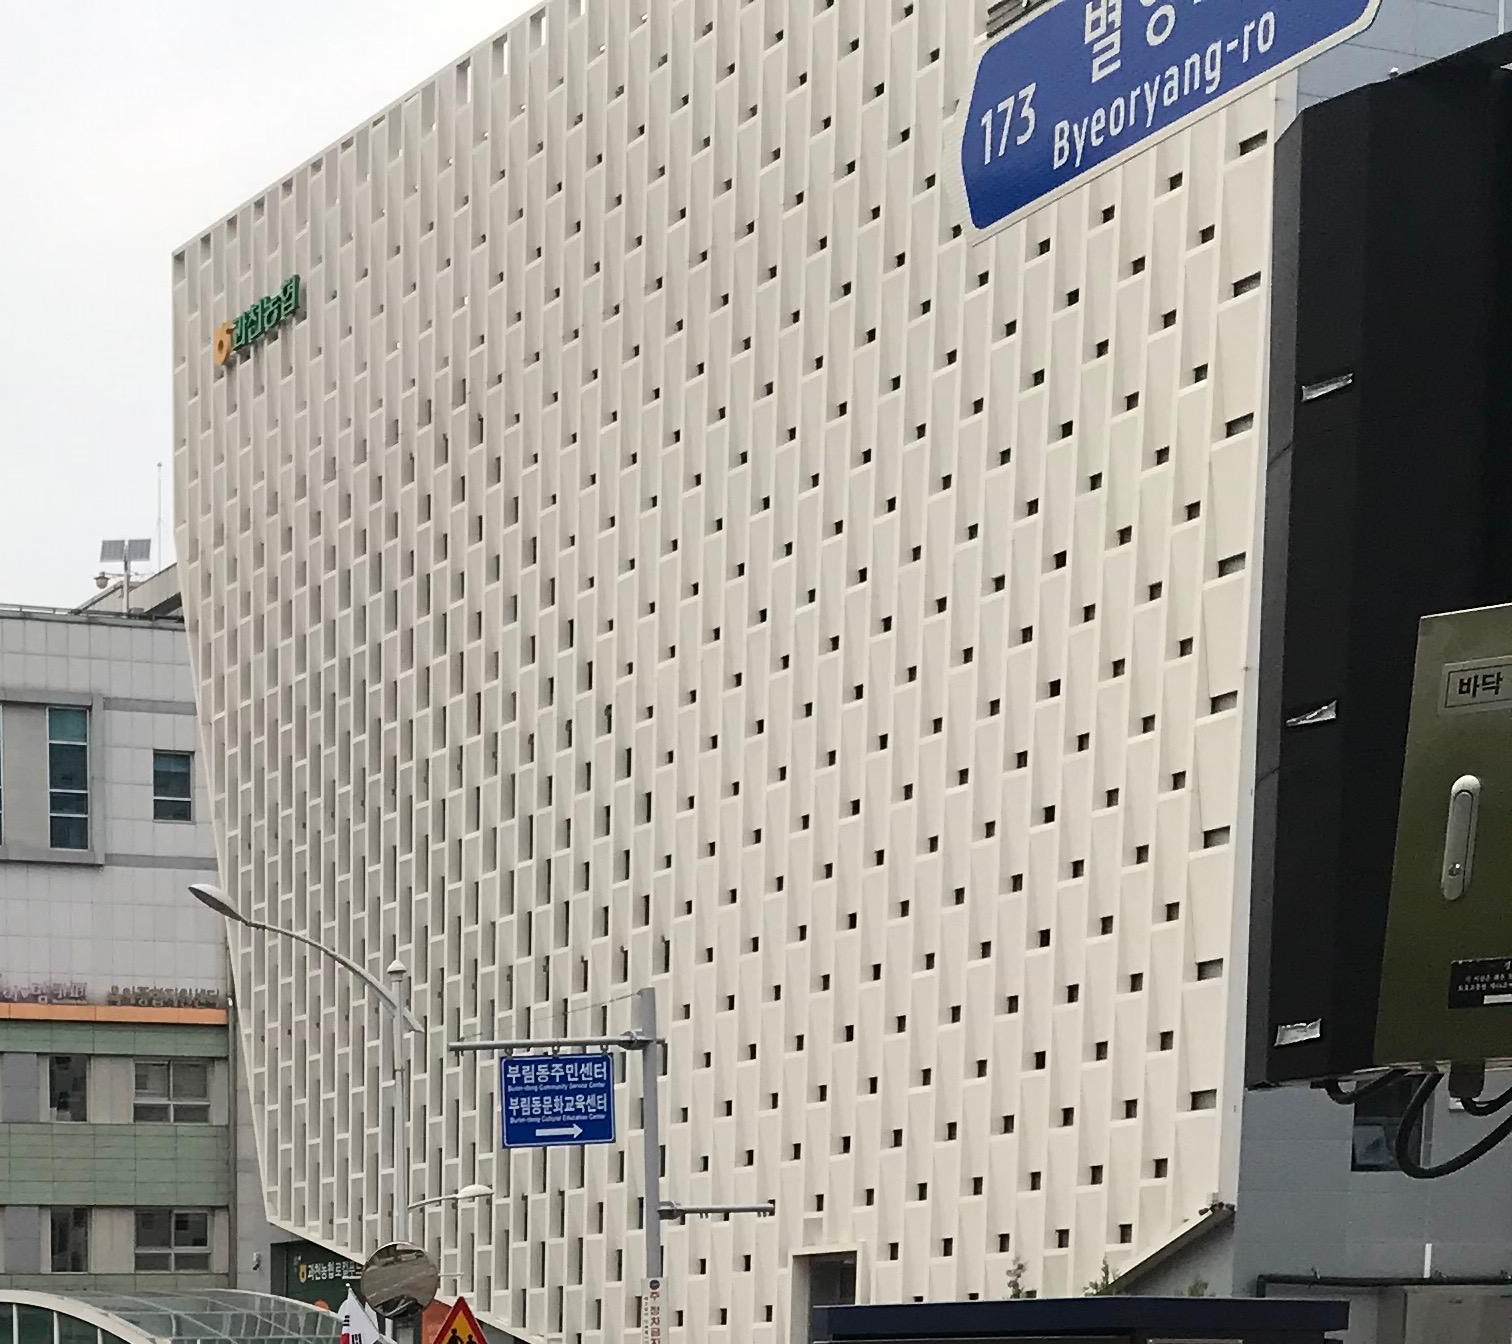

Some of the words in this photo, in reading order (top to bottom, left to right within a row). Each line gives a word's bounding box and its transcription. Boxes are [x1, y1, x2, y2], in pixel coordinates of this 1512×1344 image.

[980, 82, 1037, 165] 173
[1053, 10, 1276, 170] Byeoryang-ro
[1459, 676, 1504, 698] 바닥
[507, 1061, 607, 1084] 부림동주민센터
[508, 1093, 607, 1116] 부림동문화교육센터
